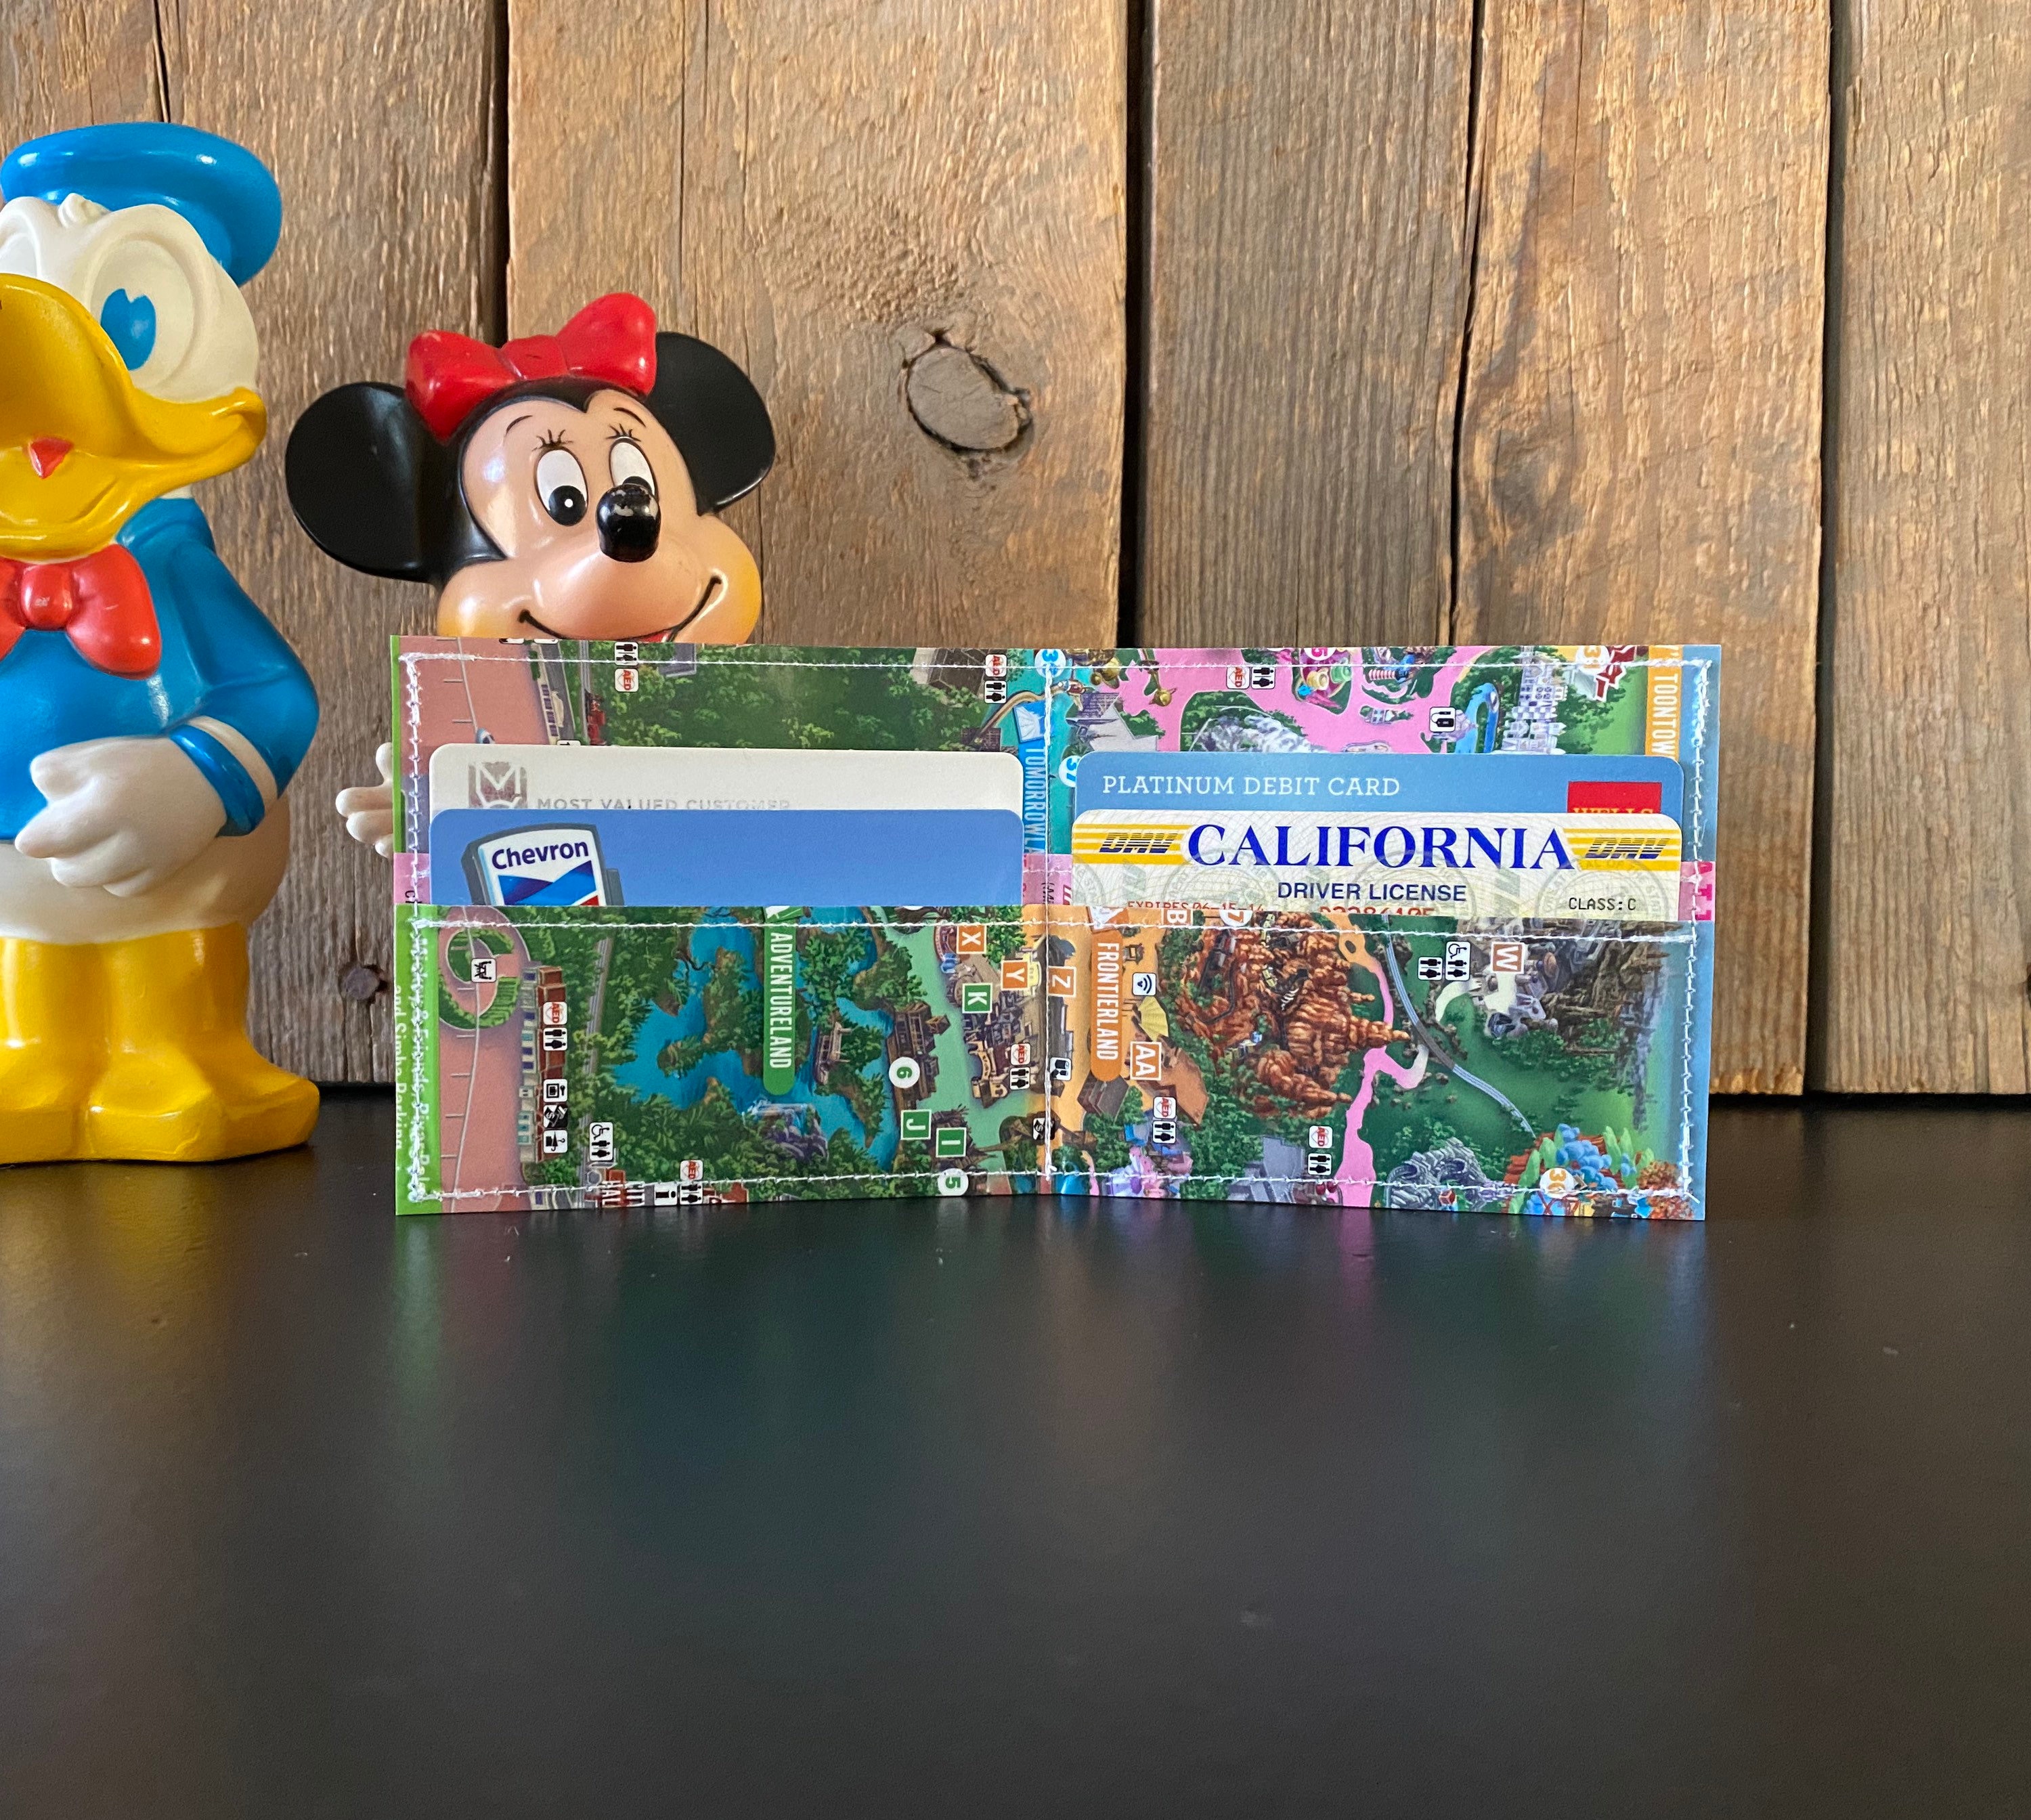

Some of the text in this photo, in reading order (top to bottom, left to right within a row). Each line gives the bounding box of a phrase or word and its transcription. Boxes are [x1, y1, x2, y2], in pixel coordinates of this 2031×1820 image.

[623, 670, 633, 691] AED
[1652, 673, 1678, 759] TOONTOW
[1103, 775, 1401, 797] PLATINUM DEBIT CARD
[538, 798, 592, 809] MOST
[1099, 832, 1178, 853] DMV
[1188, 824, 1576, 869] CALIFORNIA
[1585, 837, 1671, 859] DMV
[492, 839, 590, 871] Chevron
[1277, 882, 1467, 903] DRIVER LICENSE
[1568, 897, 1637, 911] CLASS: C
[962, 932, 982, 947] X
[1495, 946, 1519, 971] W
[1006, 968, 1026, 983] Y
[1052, 976, 1071, 989] Z
[769, 932, 792, 1069] ADVENTURELAND
[967, 991, 988, 1005] K
[1095, 942, 1120, 1062] FRONTIERLAND
[551, 1002, 561, 1023] AED
[896, 1066, 913, 1079] 6
[1135, 1047, 1156, 1077] AA
[1161, 1098, 1169, 1117] AED
[906, 1119, 925, 1131] J
[945, 1176, 961, 1189] 5
